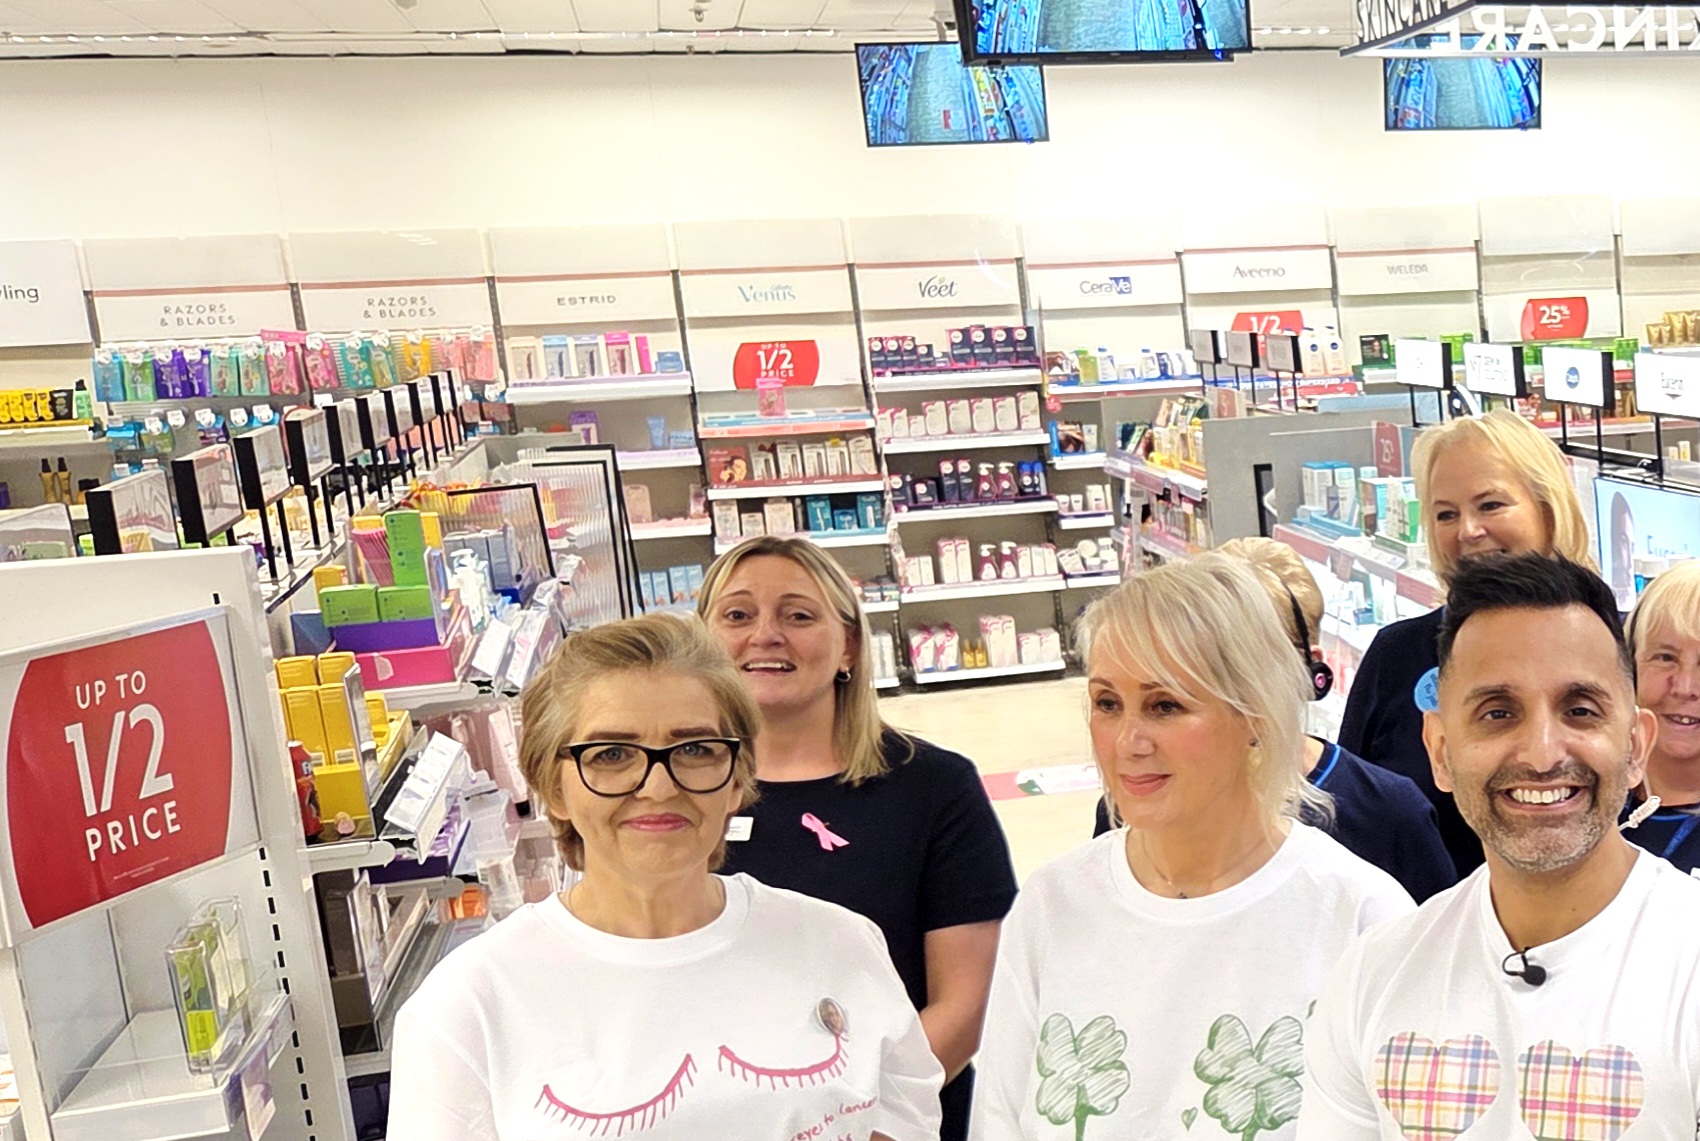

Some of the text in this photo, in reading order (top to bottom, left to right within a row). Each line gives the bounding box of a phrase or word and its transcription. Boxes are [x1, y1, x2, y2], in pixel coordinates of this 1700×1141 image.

[1233, 266, 1285, 278] Aveeno
[918, 276, 958, 298] Veet
[1080, 278, 1131, 294] CeraVe
[557, 294, 617, 306] ESTRID
[738, 285, 796, 302] Venus
[367, 296, 428, 308] RAZORS
[163, 304, 227, 315] RAZORS
[363, 307, 437, 319] & BLADES
[160, 315, 236, 327] & BLADES
[757, 349, 793, 371] 1/2
[761, 369, 794, 378] PRICE
[75, 670, 147, 710] UP TO
[64, 702, 175, 817] 1/2
[84, 800, 182, 861] PRICE
[824, 1113, 834, 1126] to
